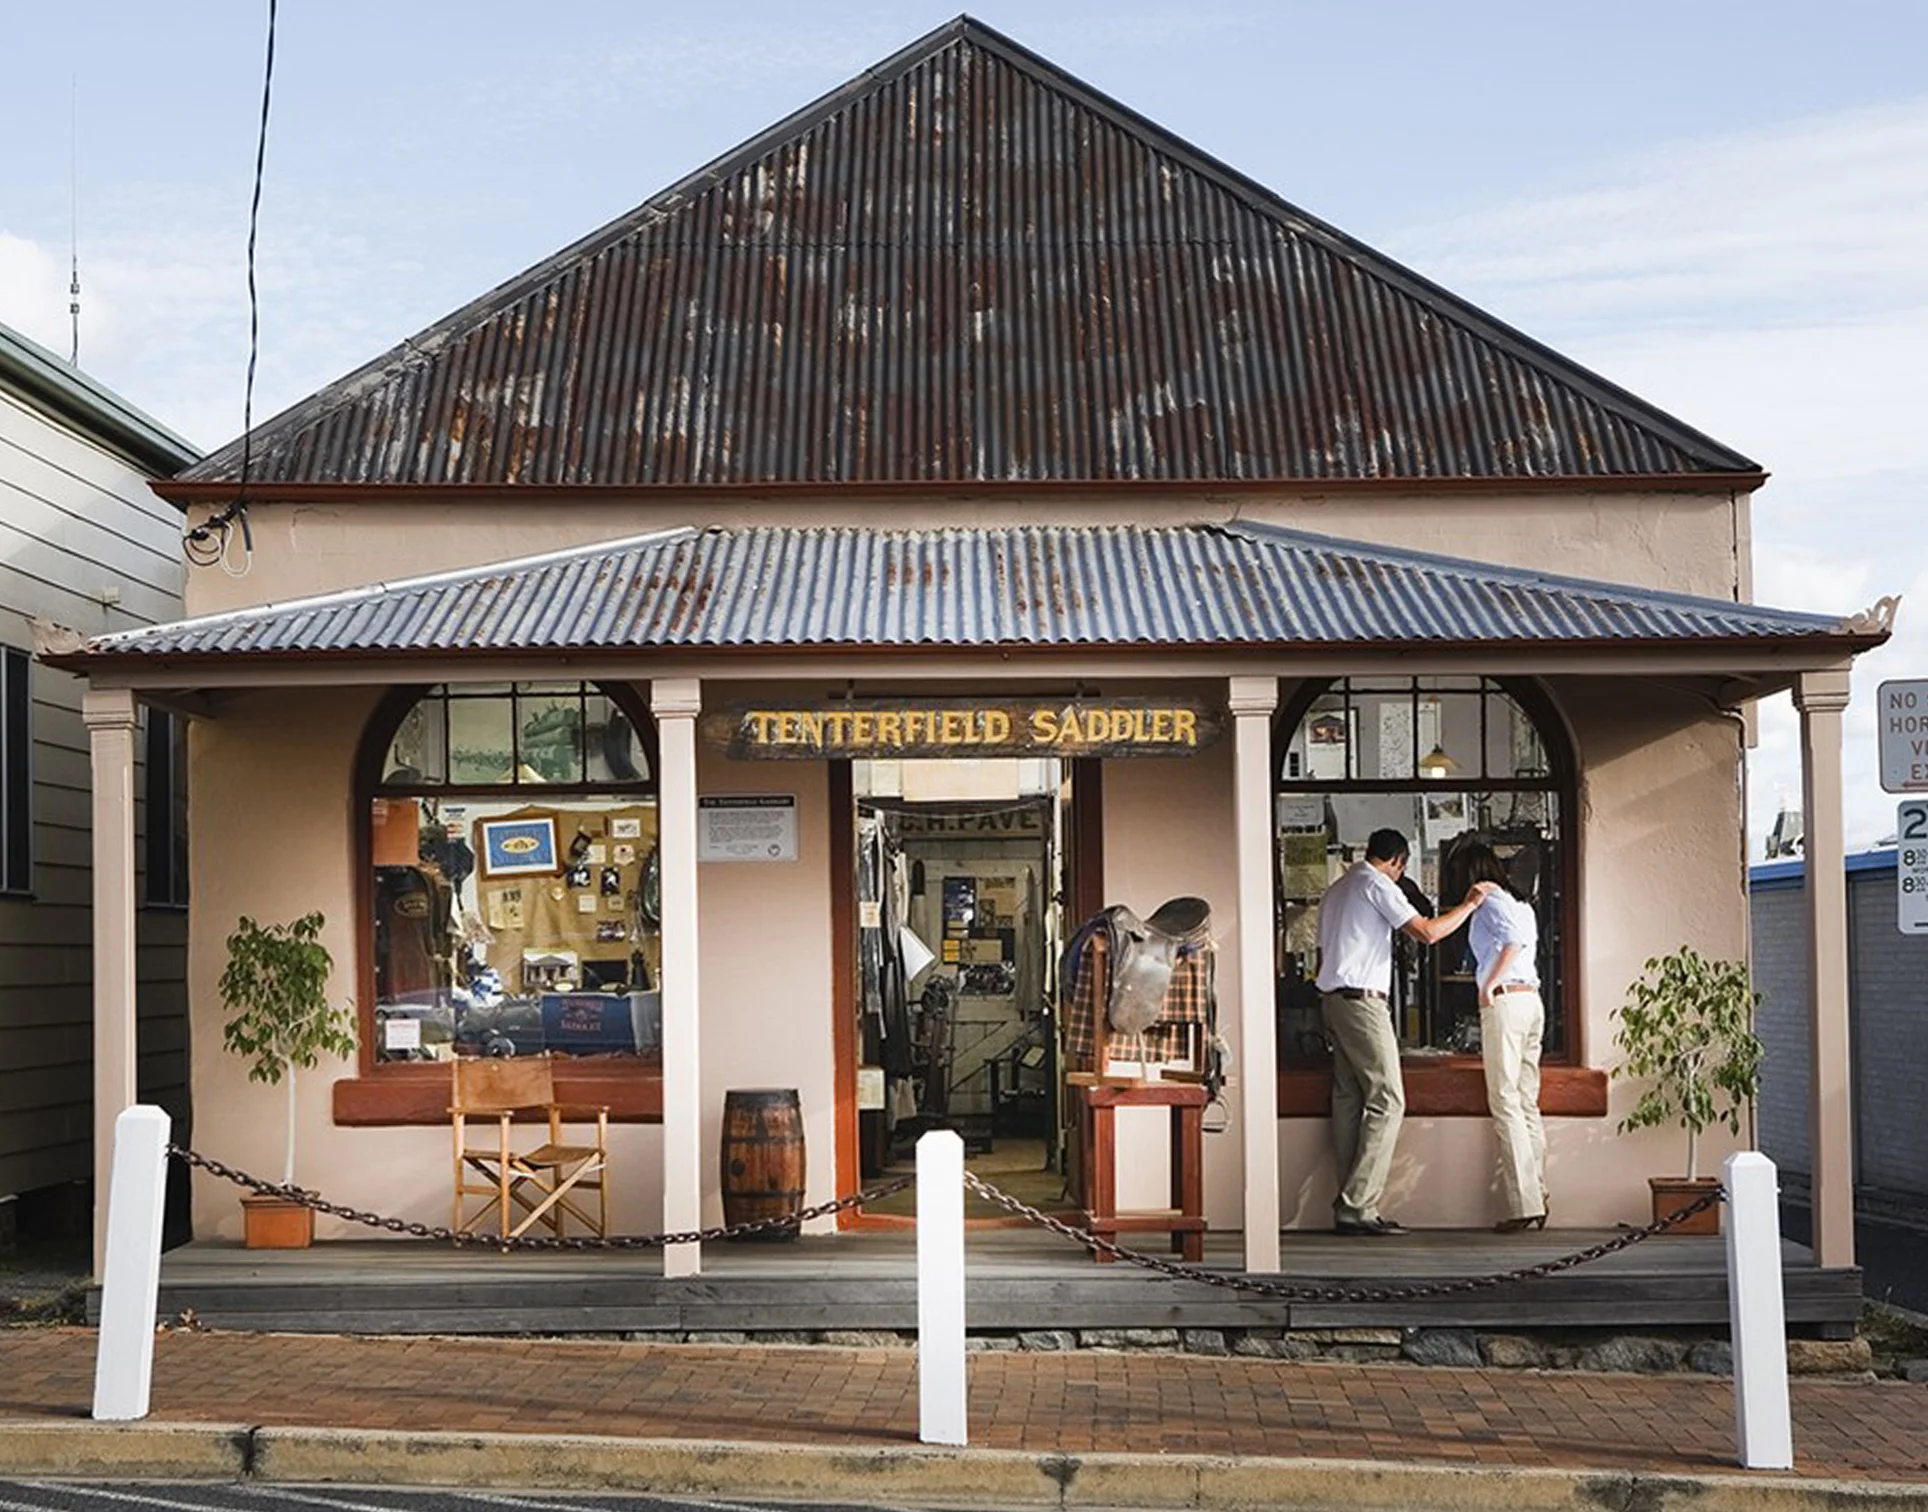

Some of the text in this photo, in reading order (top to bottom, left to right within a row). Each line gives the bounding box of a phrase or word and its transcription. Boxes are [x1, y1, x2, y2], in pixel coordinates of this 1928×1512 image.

[1890, 692, 1917, 709] NO
[748, 704, 1197, 748] TENTERFIELD SADDLER
